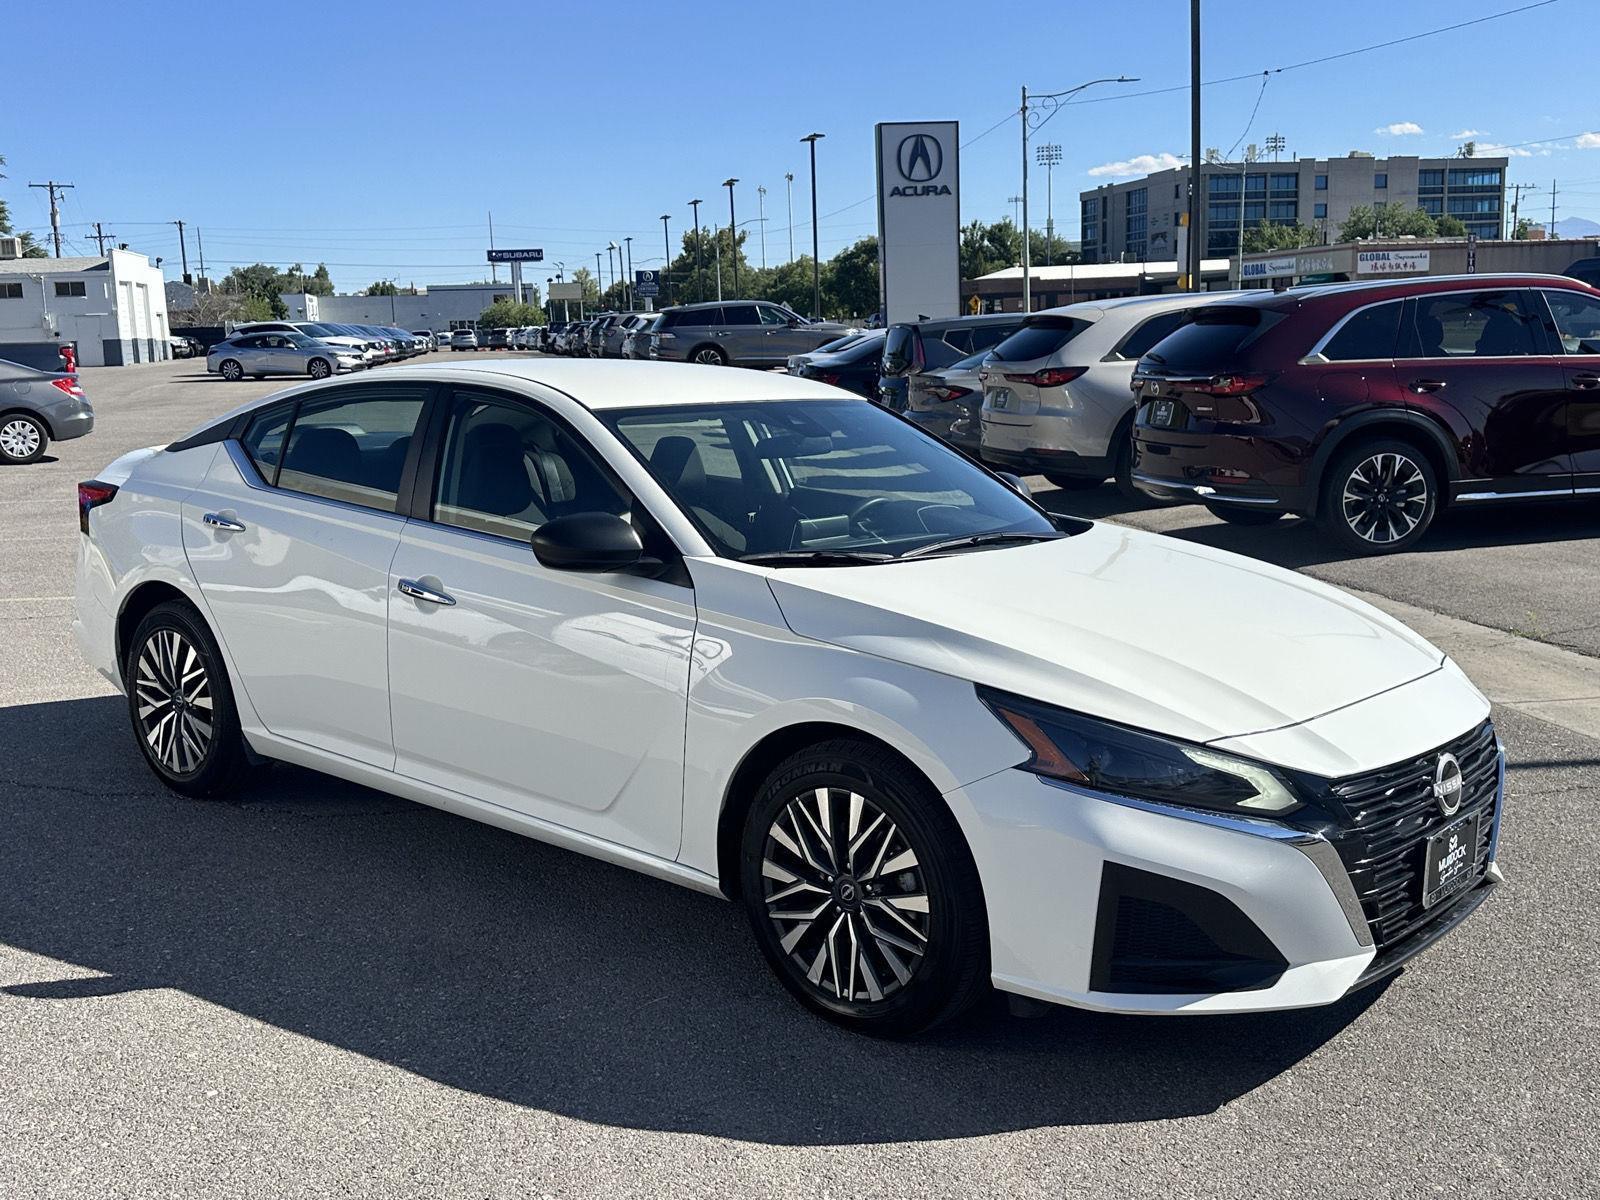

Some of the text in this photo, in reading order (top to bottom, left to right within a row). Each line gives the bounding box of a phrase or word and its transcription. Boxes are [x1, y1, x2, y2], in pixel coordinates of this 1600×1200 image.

[889, 185, 952, 197] ACURA
[502, 251, 542, 259] SUBARU
[1360, 252, 1391, 262] GLOBAL
[1243, 263, 1267, 276] GLOBAL
[767, 762, 843, 800] IRONMAN
[1434, 776, 1461, 797] NISSA
